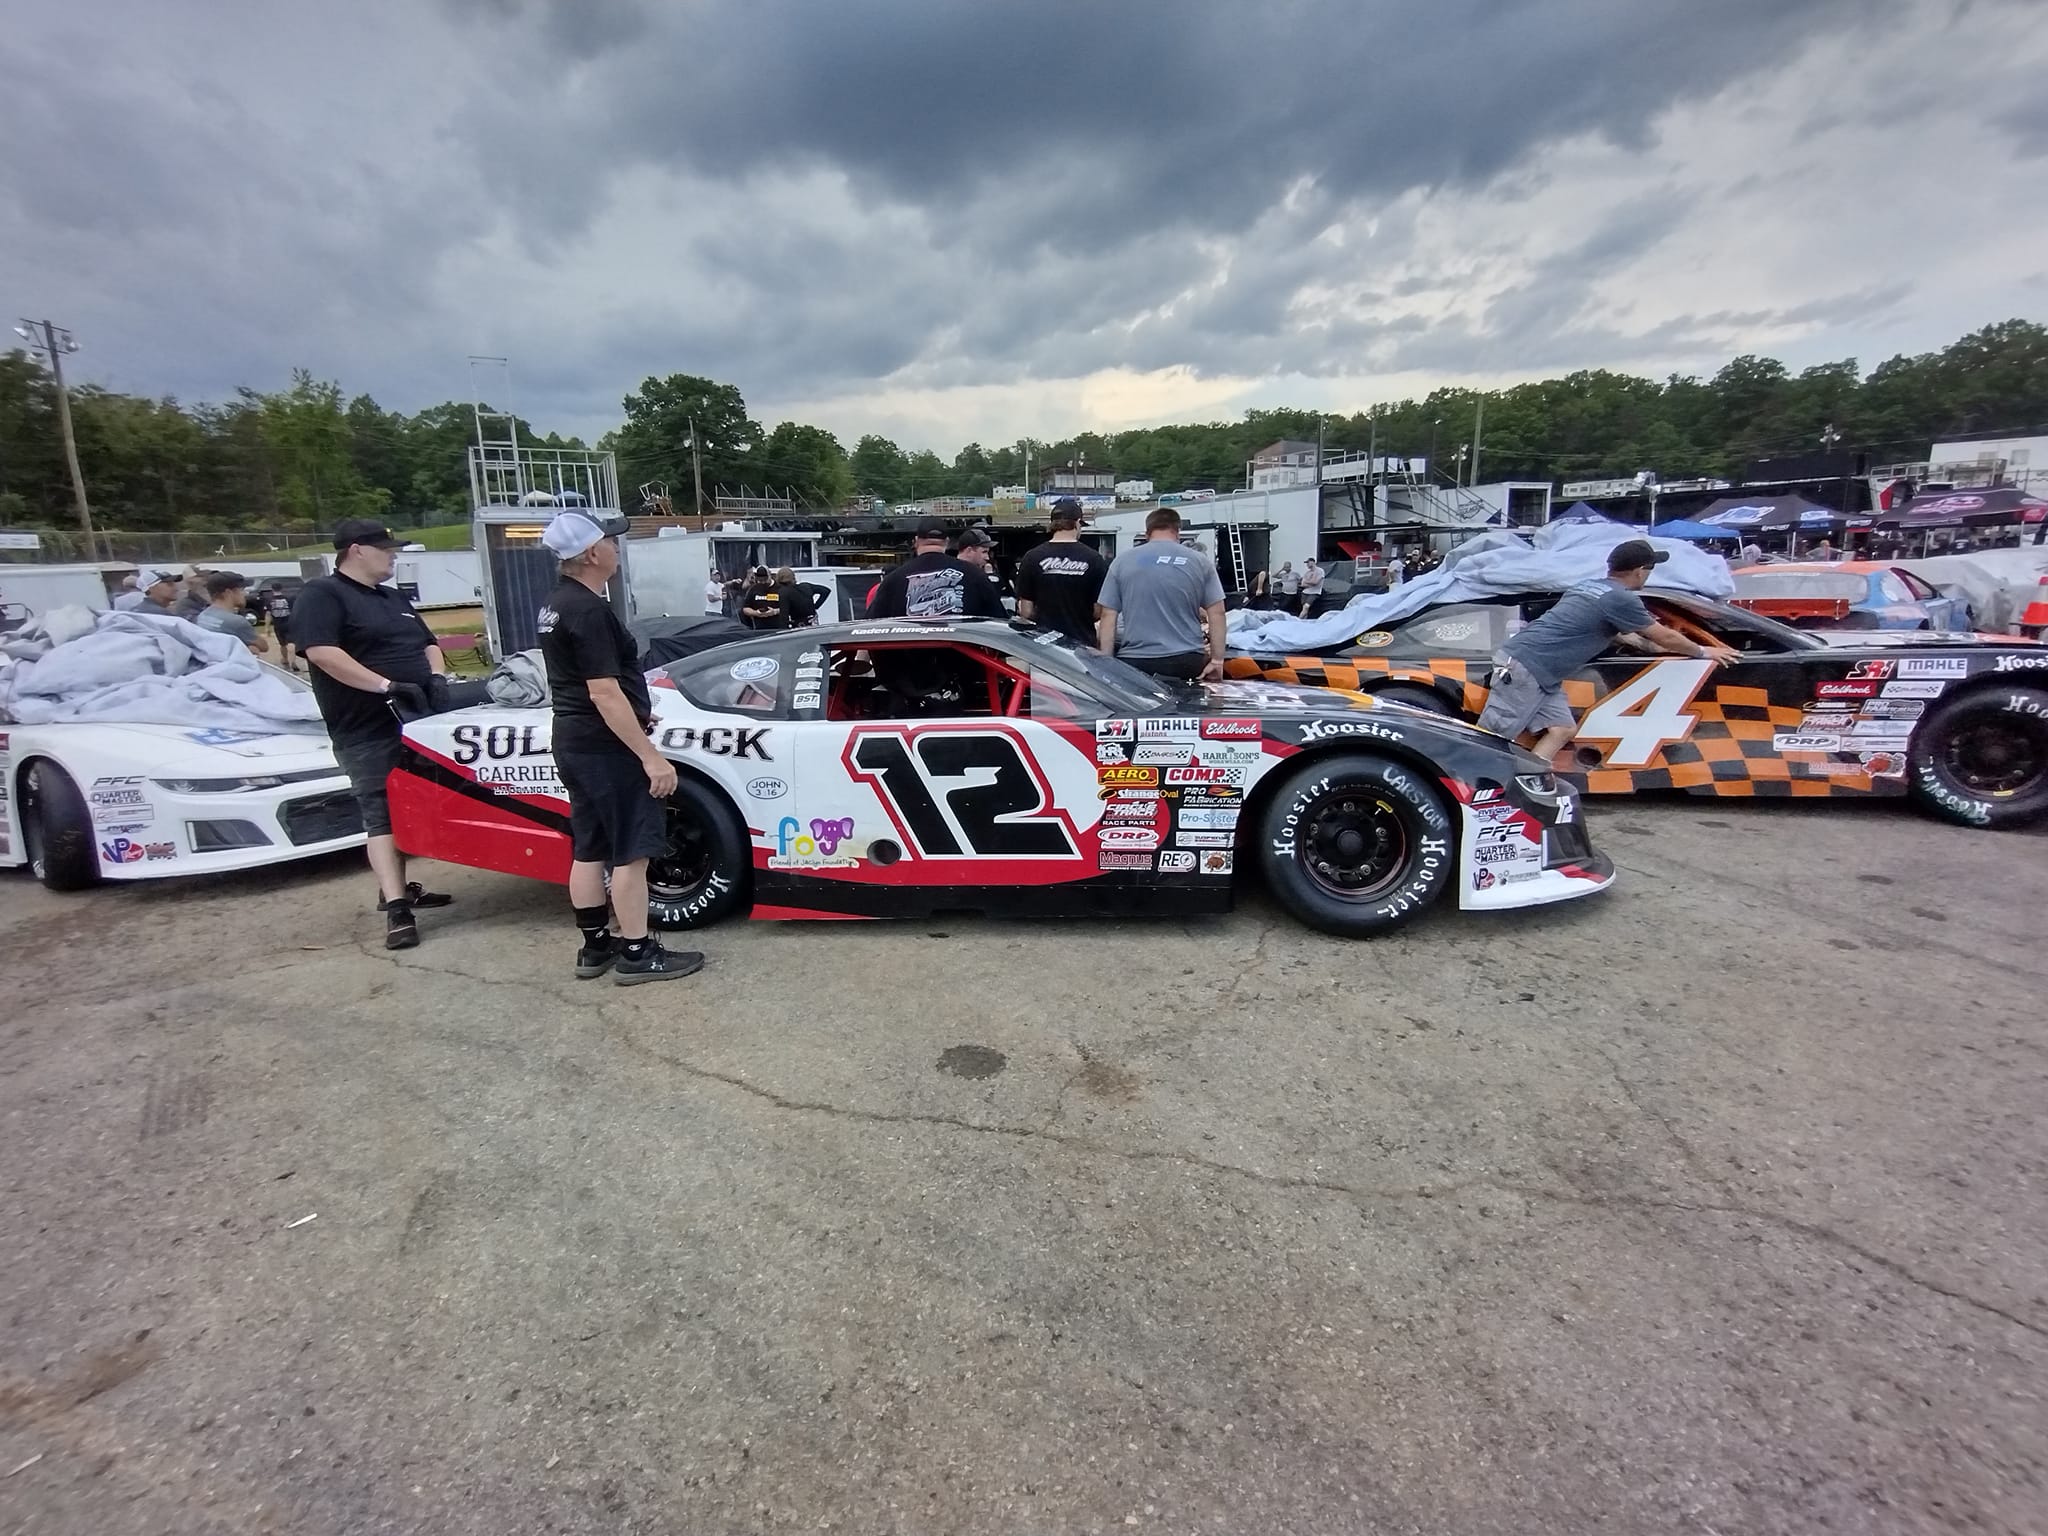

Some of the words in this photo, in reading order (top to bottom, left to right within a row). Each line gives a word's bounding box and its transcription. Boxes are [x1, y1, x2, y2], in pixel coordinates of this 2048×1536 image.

[1908, 660, 1965, 670] MAHLE
[1575, 660, 1714, 764] 4
[2002, 695, 2048, 718] Hoo
[1146, 719, 1198, 731] MAHLE
[1206, 722, 1258, 735] Edelbrock
[1299, 720, 1404, 741] Hoosier
[452, 725, 552, 765] SOL
[661, 727, 774, 761] OCK
[93, 776, 146, 785] PFC
[478, 766, 560, 781] CARRIER
[1103, 769, 1150, 780] AERO
[1168, 769, 1226, 781] COMP
[752, 781, 781, 789] JOHN
[855, 736, 1075, 856] 12
[1273, 777, 1330, 860] Hoosier
[1477, 824, 1524, 839] PFC
[1101, 852, 1152, 867] Magnus
[1390, 835, 1446, 918] Hoosier
[662, 870, 731, 922] Hoosier
